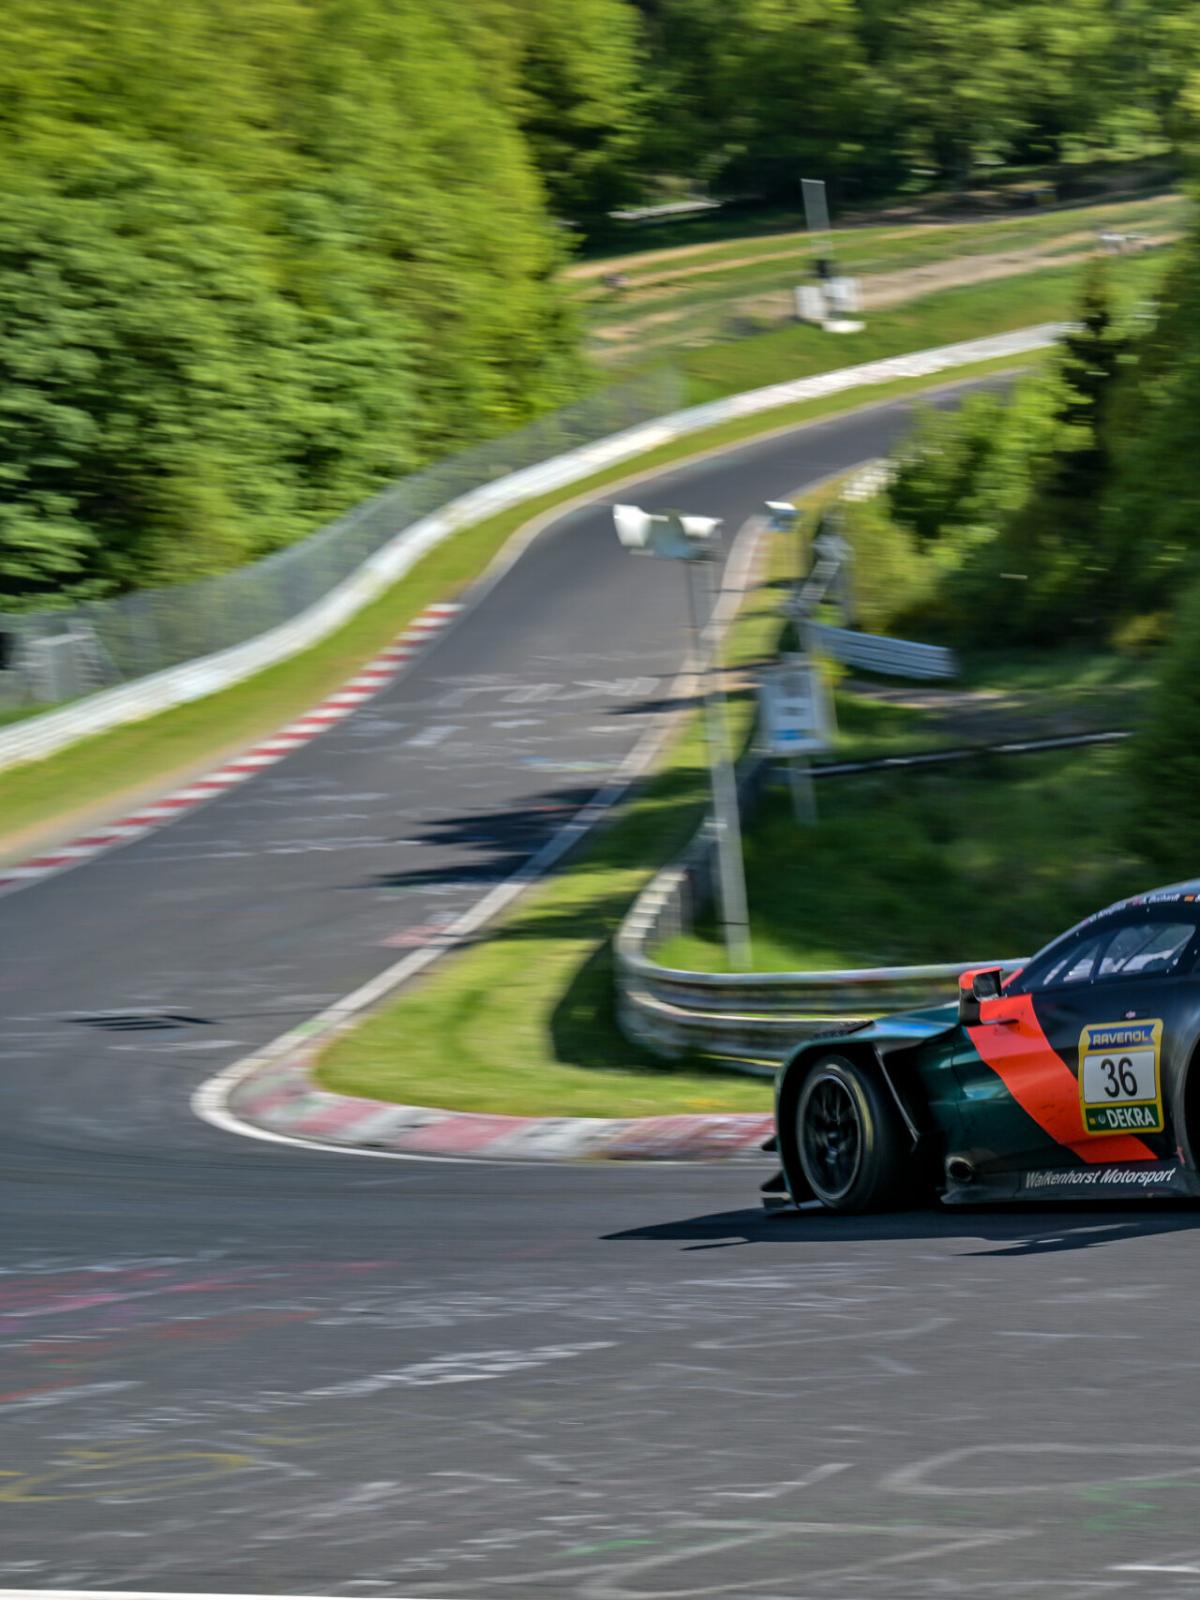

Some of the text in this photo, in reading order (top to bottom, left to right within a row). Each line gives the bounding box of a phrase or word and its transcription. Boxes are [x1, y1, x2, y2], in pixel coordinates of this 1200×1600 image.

[1092, 1030, 1149, 1045] RAVENOL
[1101, 1056, 1138, 1098] 36
[1106, 1106, 1156, 1128] DEKRA
[1025, 1167, 1177, 1189] Walkenhorst Motorsport
